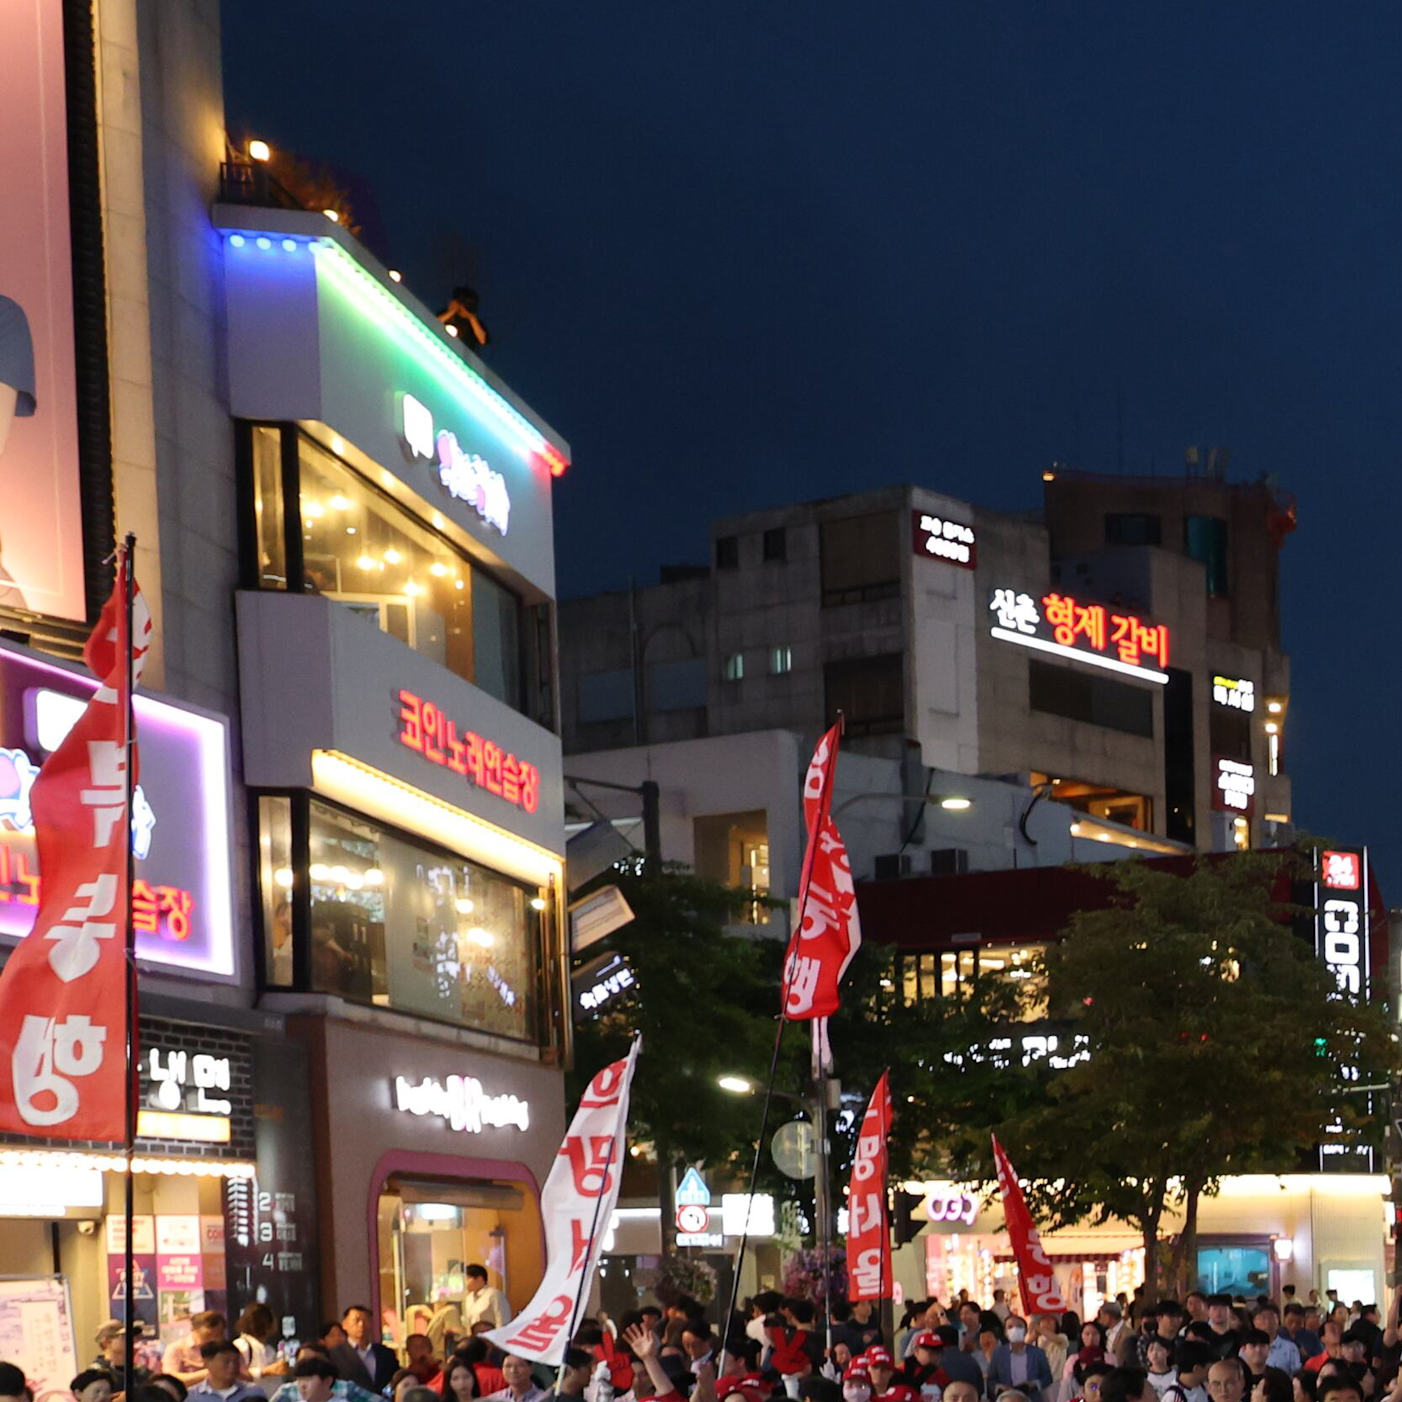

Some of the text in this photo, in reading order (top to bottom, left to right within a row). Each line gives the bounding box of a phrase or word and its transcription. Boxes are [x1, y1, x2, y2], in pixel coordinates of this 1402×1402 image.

[990, 588, 1169, 668] 신촌 형제 갈비
[399, 689, 540, 814] 코인노래연습장
[259, 1193, 271, 1212] 2
[260, 1222, 273, 1242] 3
[262, 1253, 274, 1272] 4
